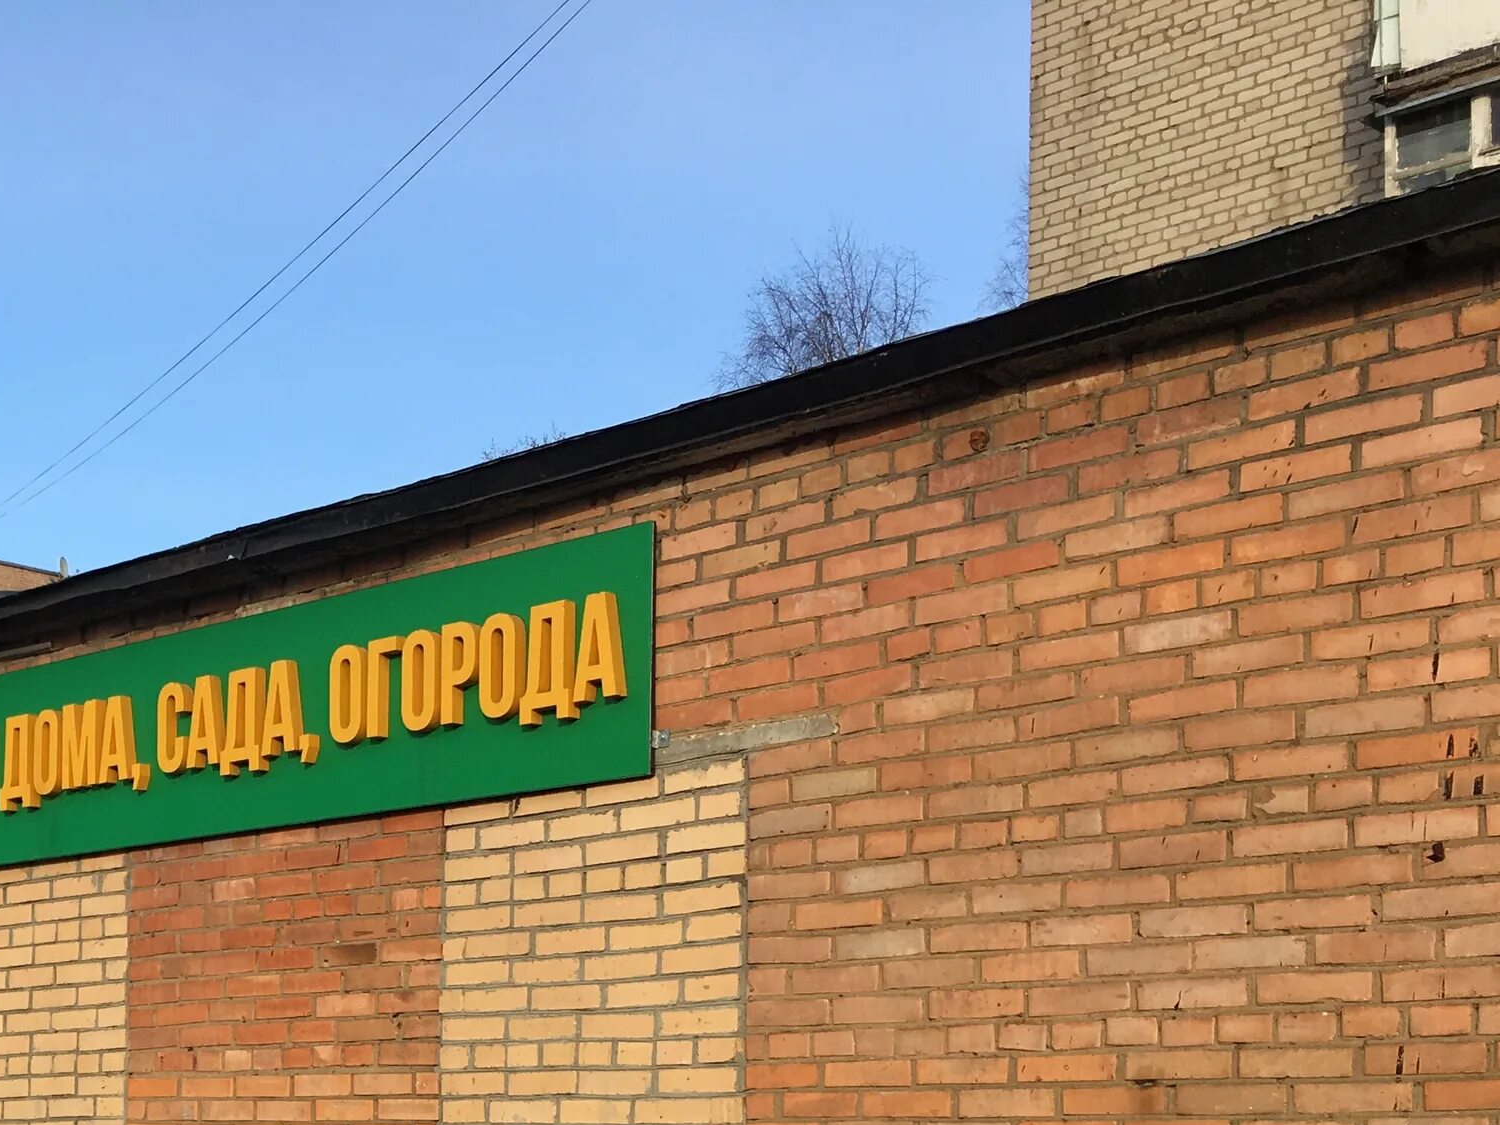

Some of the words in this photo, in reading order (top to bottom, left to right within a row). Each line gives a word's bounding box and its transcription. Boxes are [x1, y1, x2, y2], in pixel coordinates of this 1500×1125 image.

[0, 696, 151, 812] ДОМА,
[157, 660, 321, 776] САДА,
[329, 591, 628, 742] ОГОРОДА
